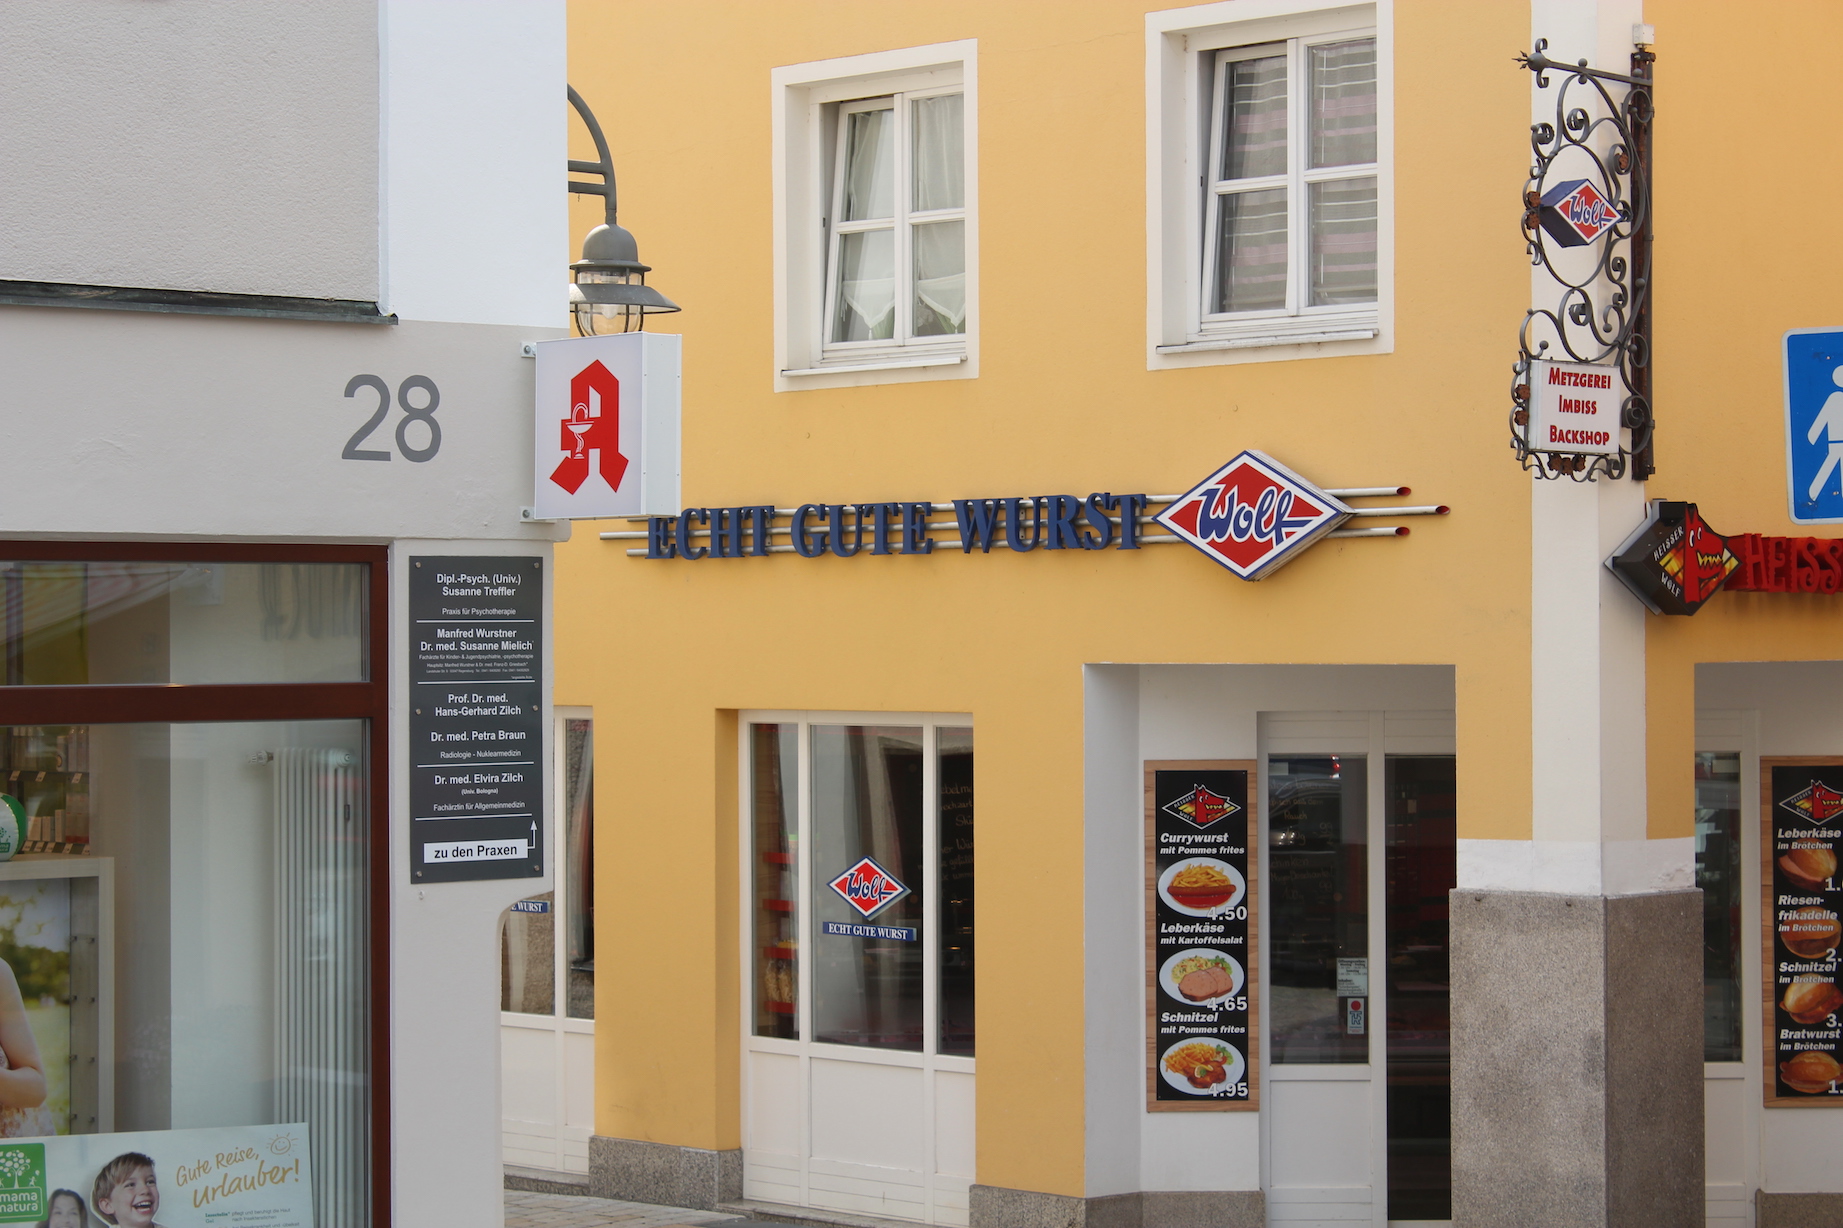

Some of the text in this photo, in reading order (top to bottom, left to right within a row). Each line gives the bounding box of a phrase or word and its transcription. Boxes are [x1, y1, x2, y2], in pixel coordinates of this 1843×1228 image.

[1570, 195, 1614, 230] Wolf
[1548, 367, 1611, 389] METZGEREI
[1558, 394, 1597, 415] IMBISS
[341, 374, 442, 463] 28
[1549, 425, 1610, 446] BACKSHOP
[1199, 487, 1314, 544] Wolf
[645, 492, 1148, 560] ECHT GUTE WURST
[1653, 525, 1684, 561] HEISSER
[436, 574, 522, 586] Dipl.-Psych. (Univ.)
[1661, 572, 1681, 598] WOLF
[442, 586, 516, 596] Susanne Treffler
[472, 608, 516, 616] Psychotherapie
[437, 628, 517, 638] Manfred Wurstner
[420, 642, 433, 651] Dr.
[436, 642, 458, 650] med.
[460, 641, 499, 650] Susanne
[448, 694, 508, 704] Prof. Dr. med.
[436, 706, 522, 716] Hans-Gerhard Zilch
[430, 730, 526, 742] Dr. med. Petra Braun
[440, 751, 472, 759] Radiologie
[434, 773, 524, 785] Dr. med. Elvira Zilch
[434, 804, 464, 812] Fachärztin
[474, 801, 526, 810] Allgemeinmedizin
[1777, 827, 1842, 838] Leberkäse
[1160, 832, 1229, 845] Currywurst
[1160, 846, 1245, 854] mit Pommes frites
[1777, 841, 1833, 850] im Brötchen
[434, 845, 518, 859] zu den Praxen
[847, 872, 896, 902] Wolf
[1824, 876, 1843, 892] 1.
[1778, 895, 1824, 906] Riesen-
[518, 902, 543, 912] WURST
[1207, 906, 1248, 920] 4.50
[1778, 910, 1838, 921] frikadelle
[828, 923, 908, 940] ECHT GUTE WURST
[1160, 923, 1225, 934] Leberkäse
[1778, 924, 1834, 932] im Brötchen
[1160, 936, 1244, 944] mit Kartoffelsalat
[1779, 962, 1836, 972] Schnitzel
[1792, 976, 1834, 984] Brötchen
[1206, 996, 1248, 1011] 4.65
[1160, 1012, 1218, 1022] Schnitzel
[1160, 1026, 1246, 1034] mit Pommes frites
[1780, 1029, 1840, 1040] Bratwurst
[1780, 1042, 1836, 1050] im Brötchen
[1207, 1082, 1248, 1097] 4.95
[176, 1146, 260, 1187] Gute Reise,
[0, 1192, 38, 1202] mama
[0, 1202, 38, 1213] natura
